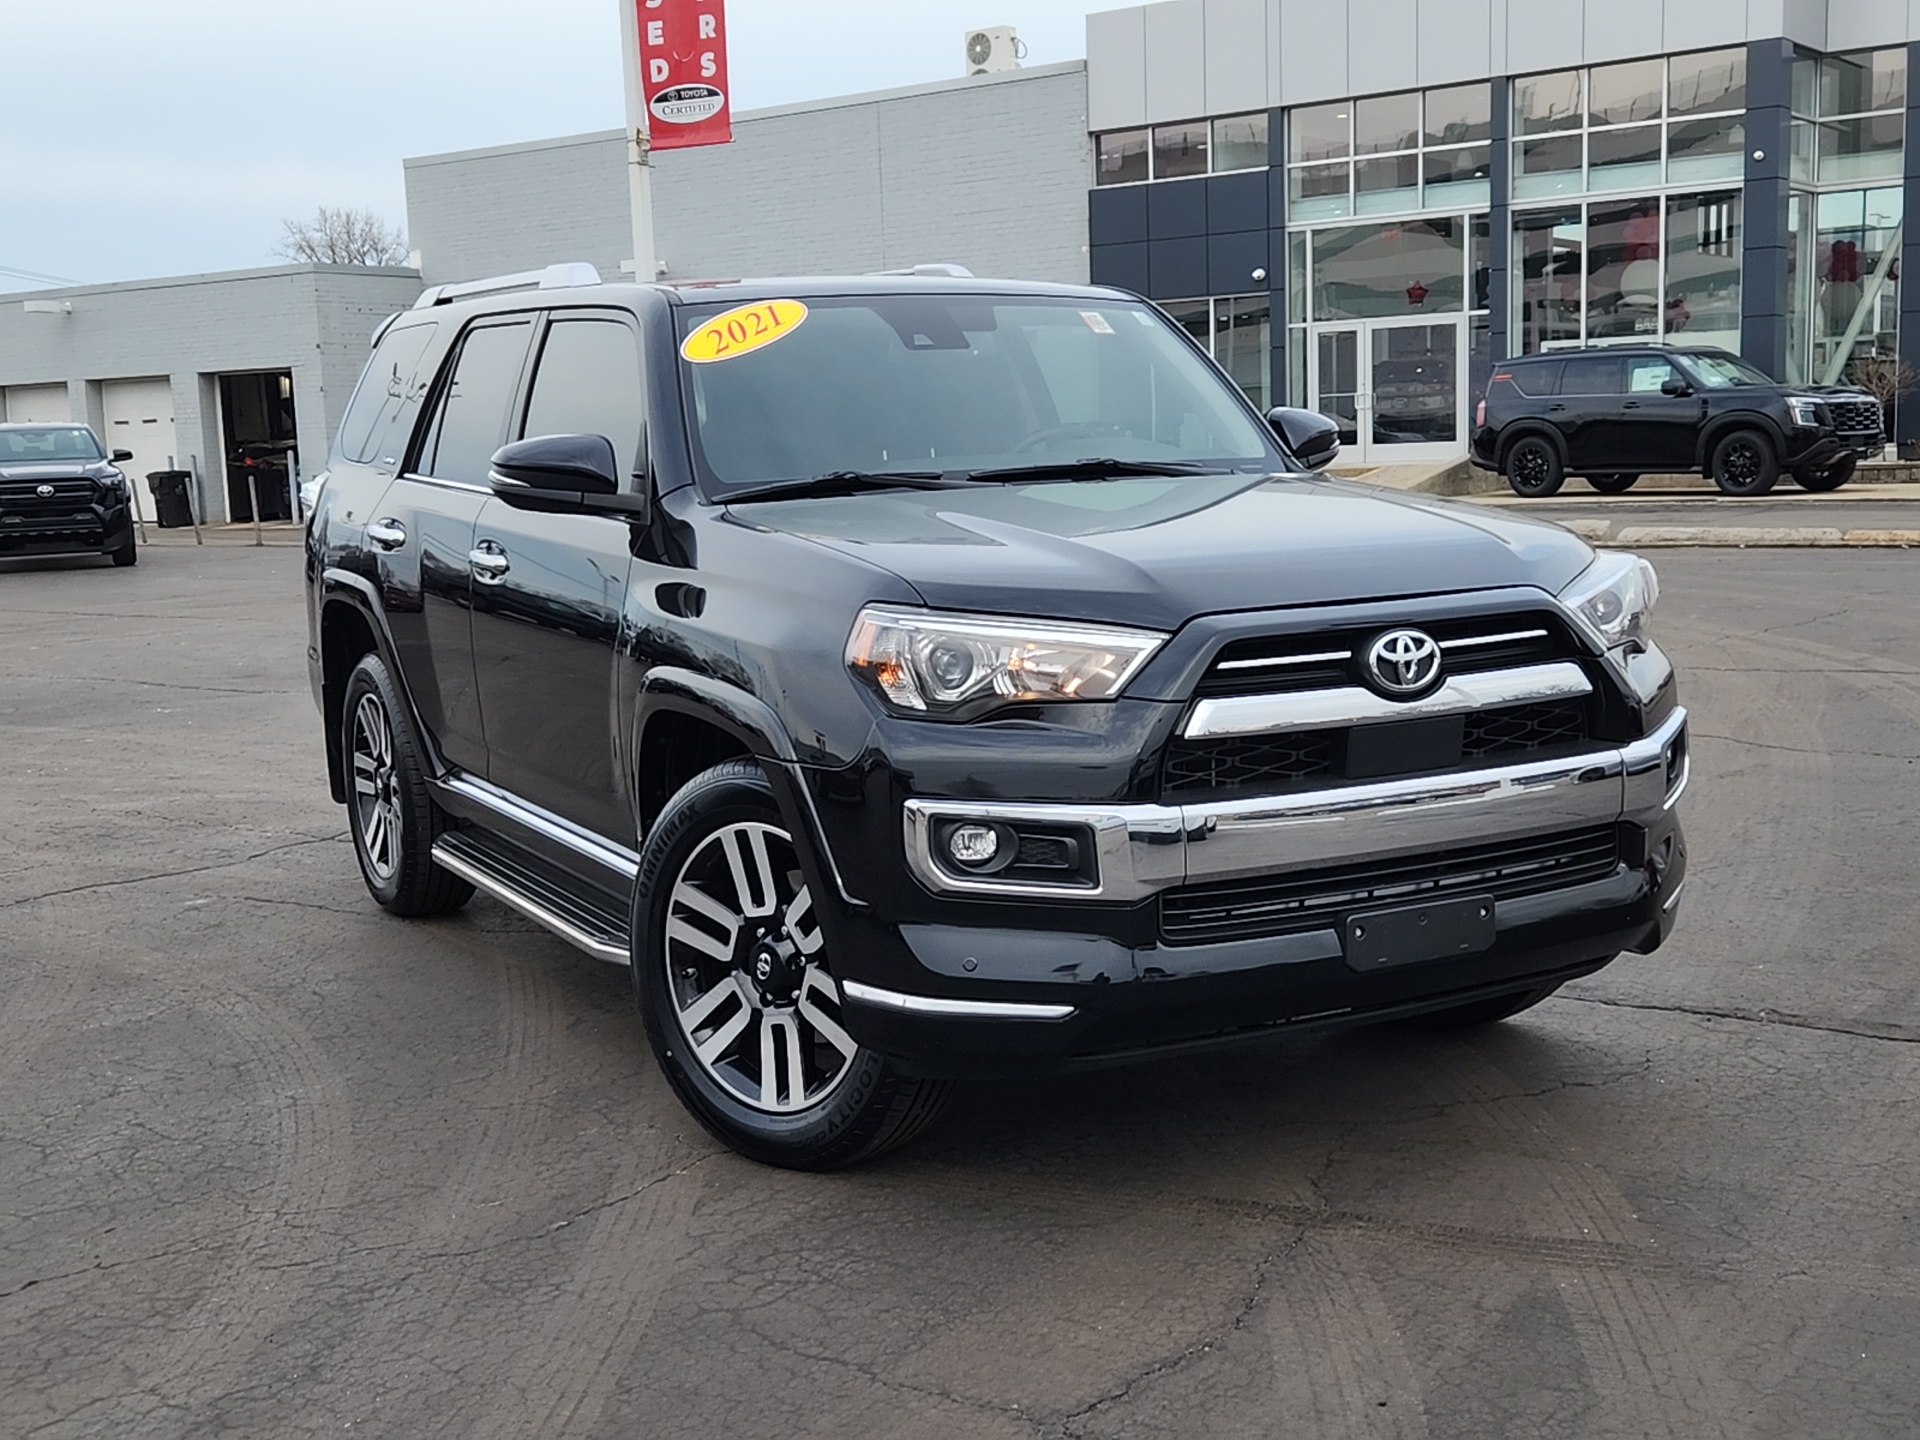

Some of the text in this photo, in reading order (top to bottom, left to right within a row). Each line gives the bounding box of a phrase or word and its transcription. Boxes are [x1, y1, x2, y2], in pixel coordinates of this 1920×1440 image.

[697, 0, 717, 77] RS
[680, 89, 708, 99] TOYOTA
[706, 304, 786, 356] 2021
